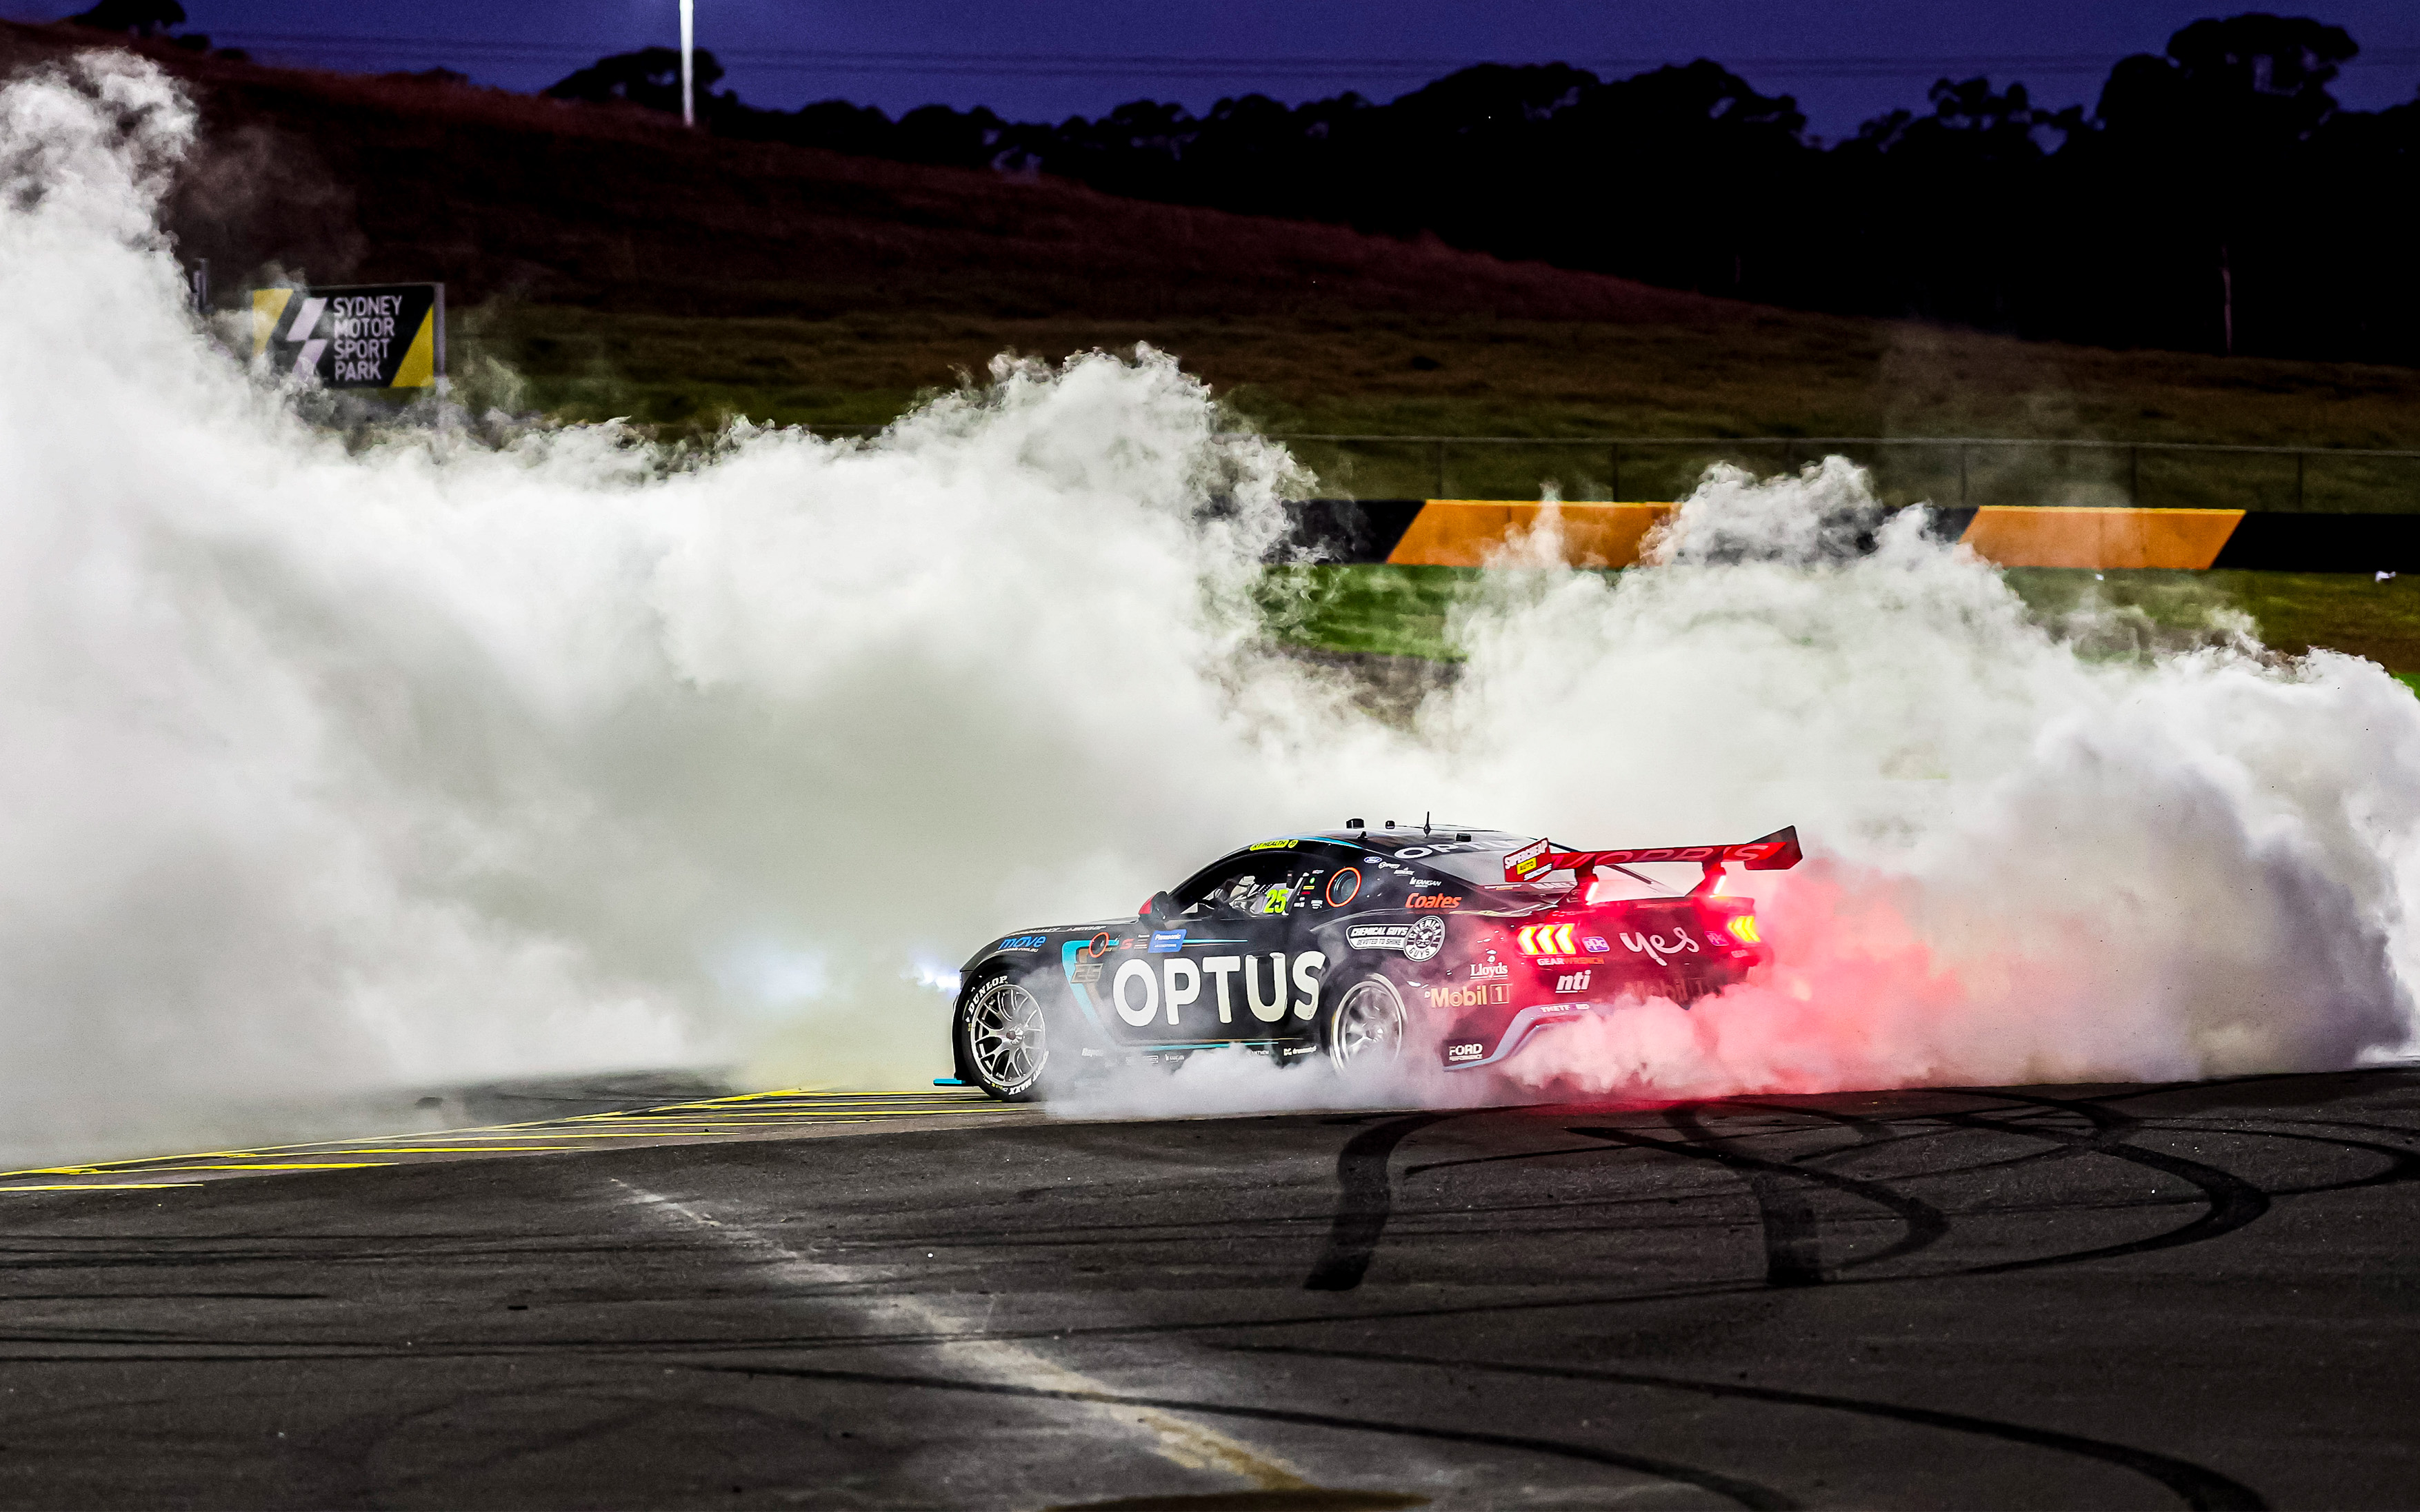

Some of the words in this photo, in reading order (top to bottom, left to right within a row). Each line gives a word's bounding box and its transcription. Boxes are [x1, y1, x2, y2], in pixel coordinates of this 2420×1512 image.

[334, 294, 403, 318] SYDNEY
[334, 317, 396, 339] MOTOR
[334, 339, 391, 359] SPORT
[334, 359, 382, 381] PARK
[1263, 889, 1289, 914] 25
[1405, 893, 1463, 909] Coates
[1350, 927, 1386, 937] CHEMICAL
[1386, 927, 1409, 936] GUYS
[1409, 919, 1442, 940] CHEMICAL
[998, 936, 1047, 950] move
[1409, 947, 1430, 958] GUYS
[1585, 938, 1608, 951] PPG
[1619, 927, 1700, 967] yes
[1470, 962, 1508, 978] Lloyds
[1537, 956, 1605, 965] GEARWRENCH
[1112, 951, 1326, 1027] OPTUS
[1556, 969, 1592, 991] nti
[968, 975, 1008, 1015] DUNLOP
[1430, 985, 1488, 1008] Mobil
[1540, 1003, 1590, 1013] THETFRD
[1449, 1043, 1483, 1056] FORD
